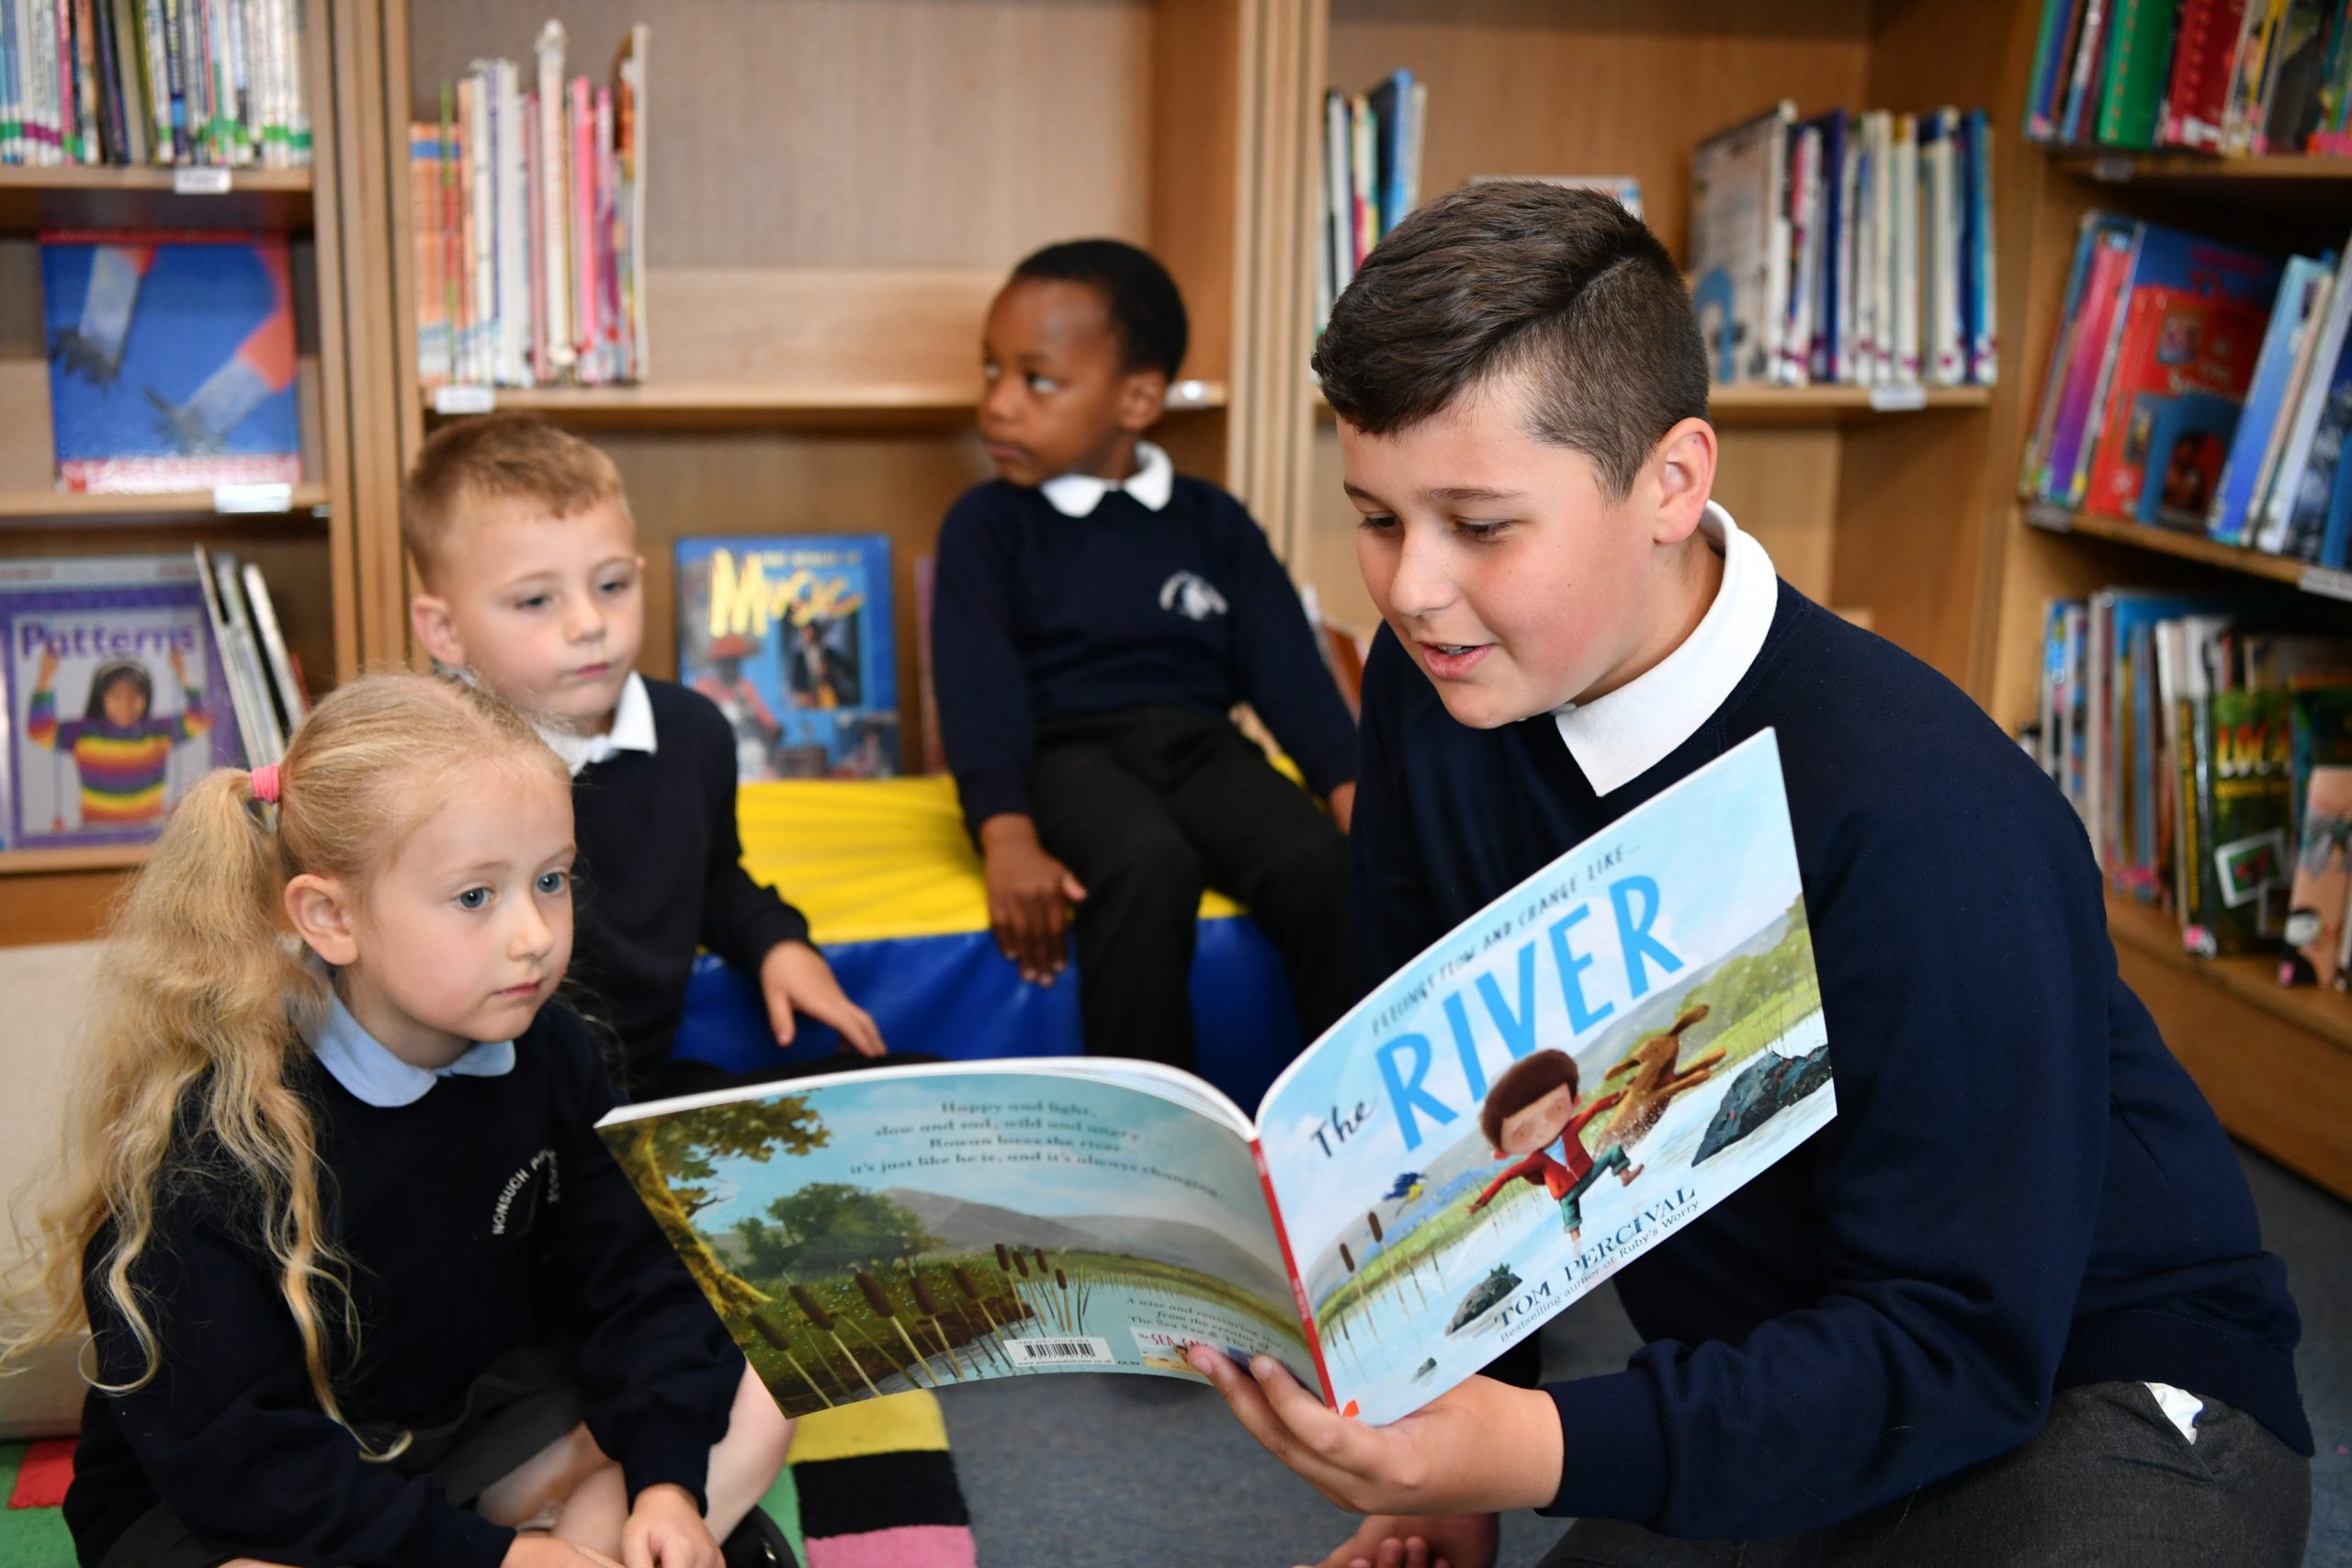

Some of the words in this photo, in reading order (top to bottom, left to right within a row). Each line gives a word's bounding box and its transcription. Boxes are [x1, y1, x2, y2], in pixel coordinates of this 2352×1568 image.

[1439, 951, 1475, 979] FLOW
[1483, 922, 1512, 950] AND
[1518, 877, 1577, 926] CHANGE
[1309, 1100, 1376, 1158] The
[1376, 875, 1686, 1152] RIVER
[875, 1125, 914, 1137] slow
[920, 1120, 955, 1132] and
[1004, 1117, 1042, 1129] wild
[1047, 1120, 1082, 1132] and
[942, 1102, 1001, 1114] Happy
[1008, 1101, 1044, 1111] and
[1046, 1135, 1074, 1146] the
[851, 1163, 875, 1175] it's
[881, 1159, 912, 1174] just
[919, 1156, 950, 1167] like
[956, 1154, 977, 1164] he
[1008, 1151, 1042, 1162] and
[1047, 1152, 1071, 1164] it's
[492, 1168, 530, 1235] NONSUCH
[1495, 1280, 1551, 1326] TOM
[1564, 1186, 1696, 1281] PERCIVAL
[1500, 1295, 1562, 1342] Bestselling
[1564, 1269, 1600, 1297] author
[1603, 1257, 1617, 1274] of
[1620, 1228, 1659, 1258] Ruby's
[1661, 1200, 1699, 1229] Worry
